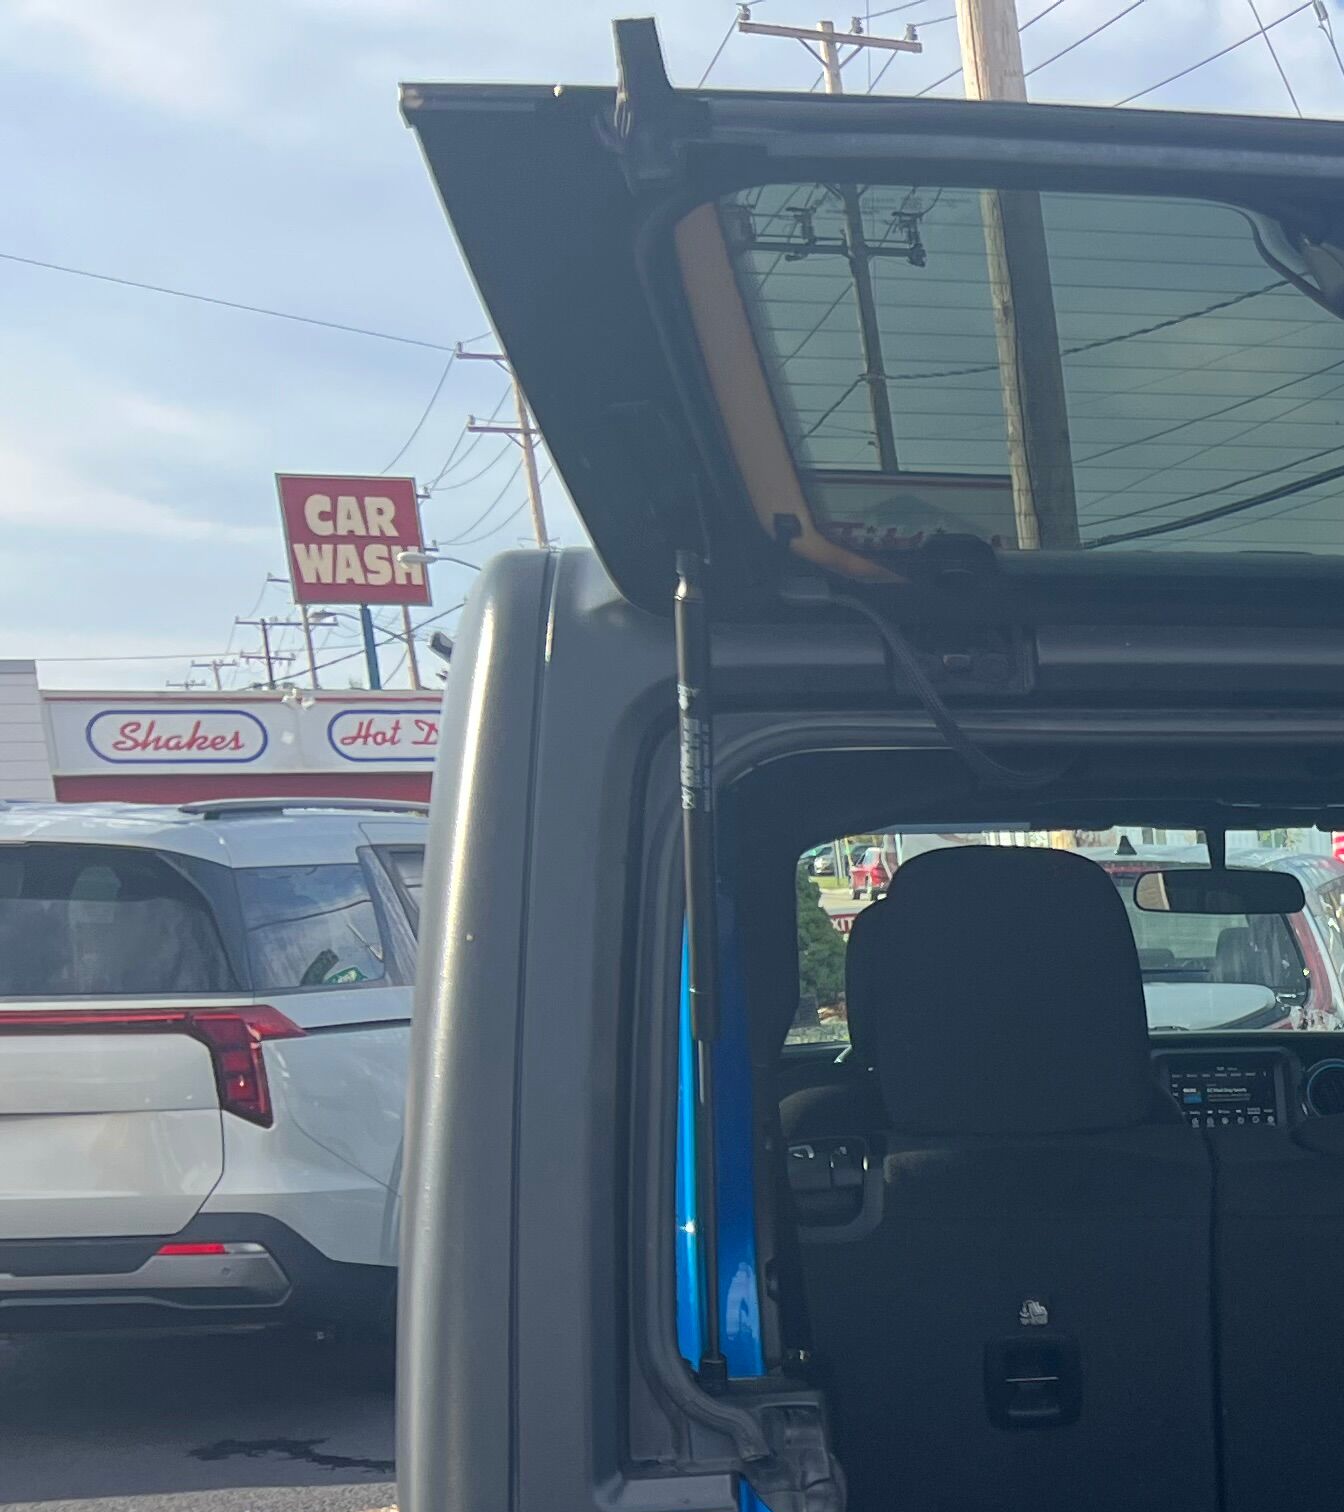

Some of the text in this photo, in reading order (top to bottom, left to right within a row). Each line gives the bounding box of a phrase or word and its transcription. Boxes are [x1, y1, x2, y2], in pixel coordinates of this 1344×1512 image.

[304, 494, 399, 537] CAR
[293, 543, 424, 585] WASH
[111, 720, 245, 751] Shakes
[340, 718, 401, 746] Hot
